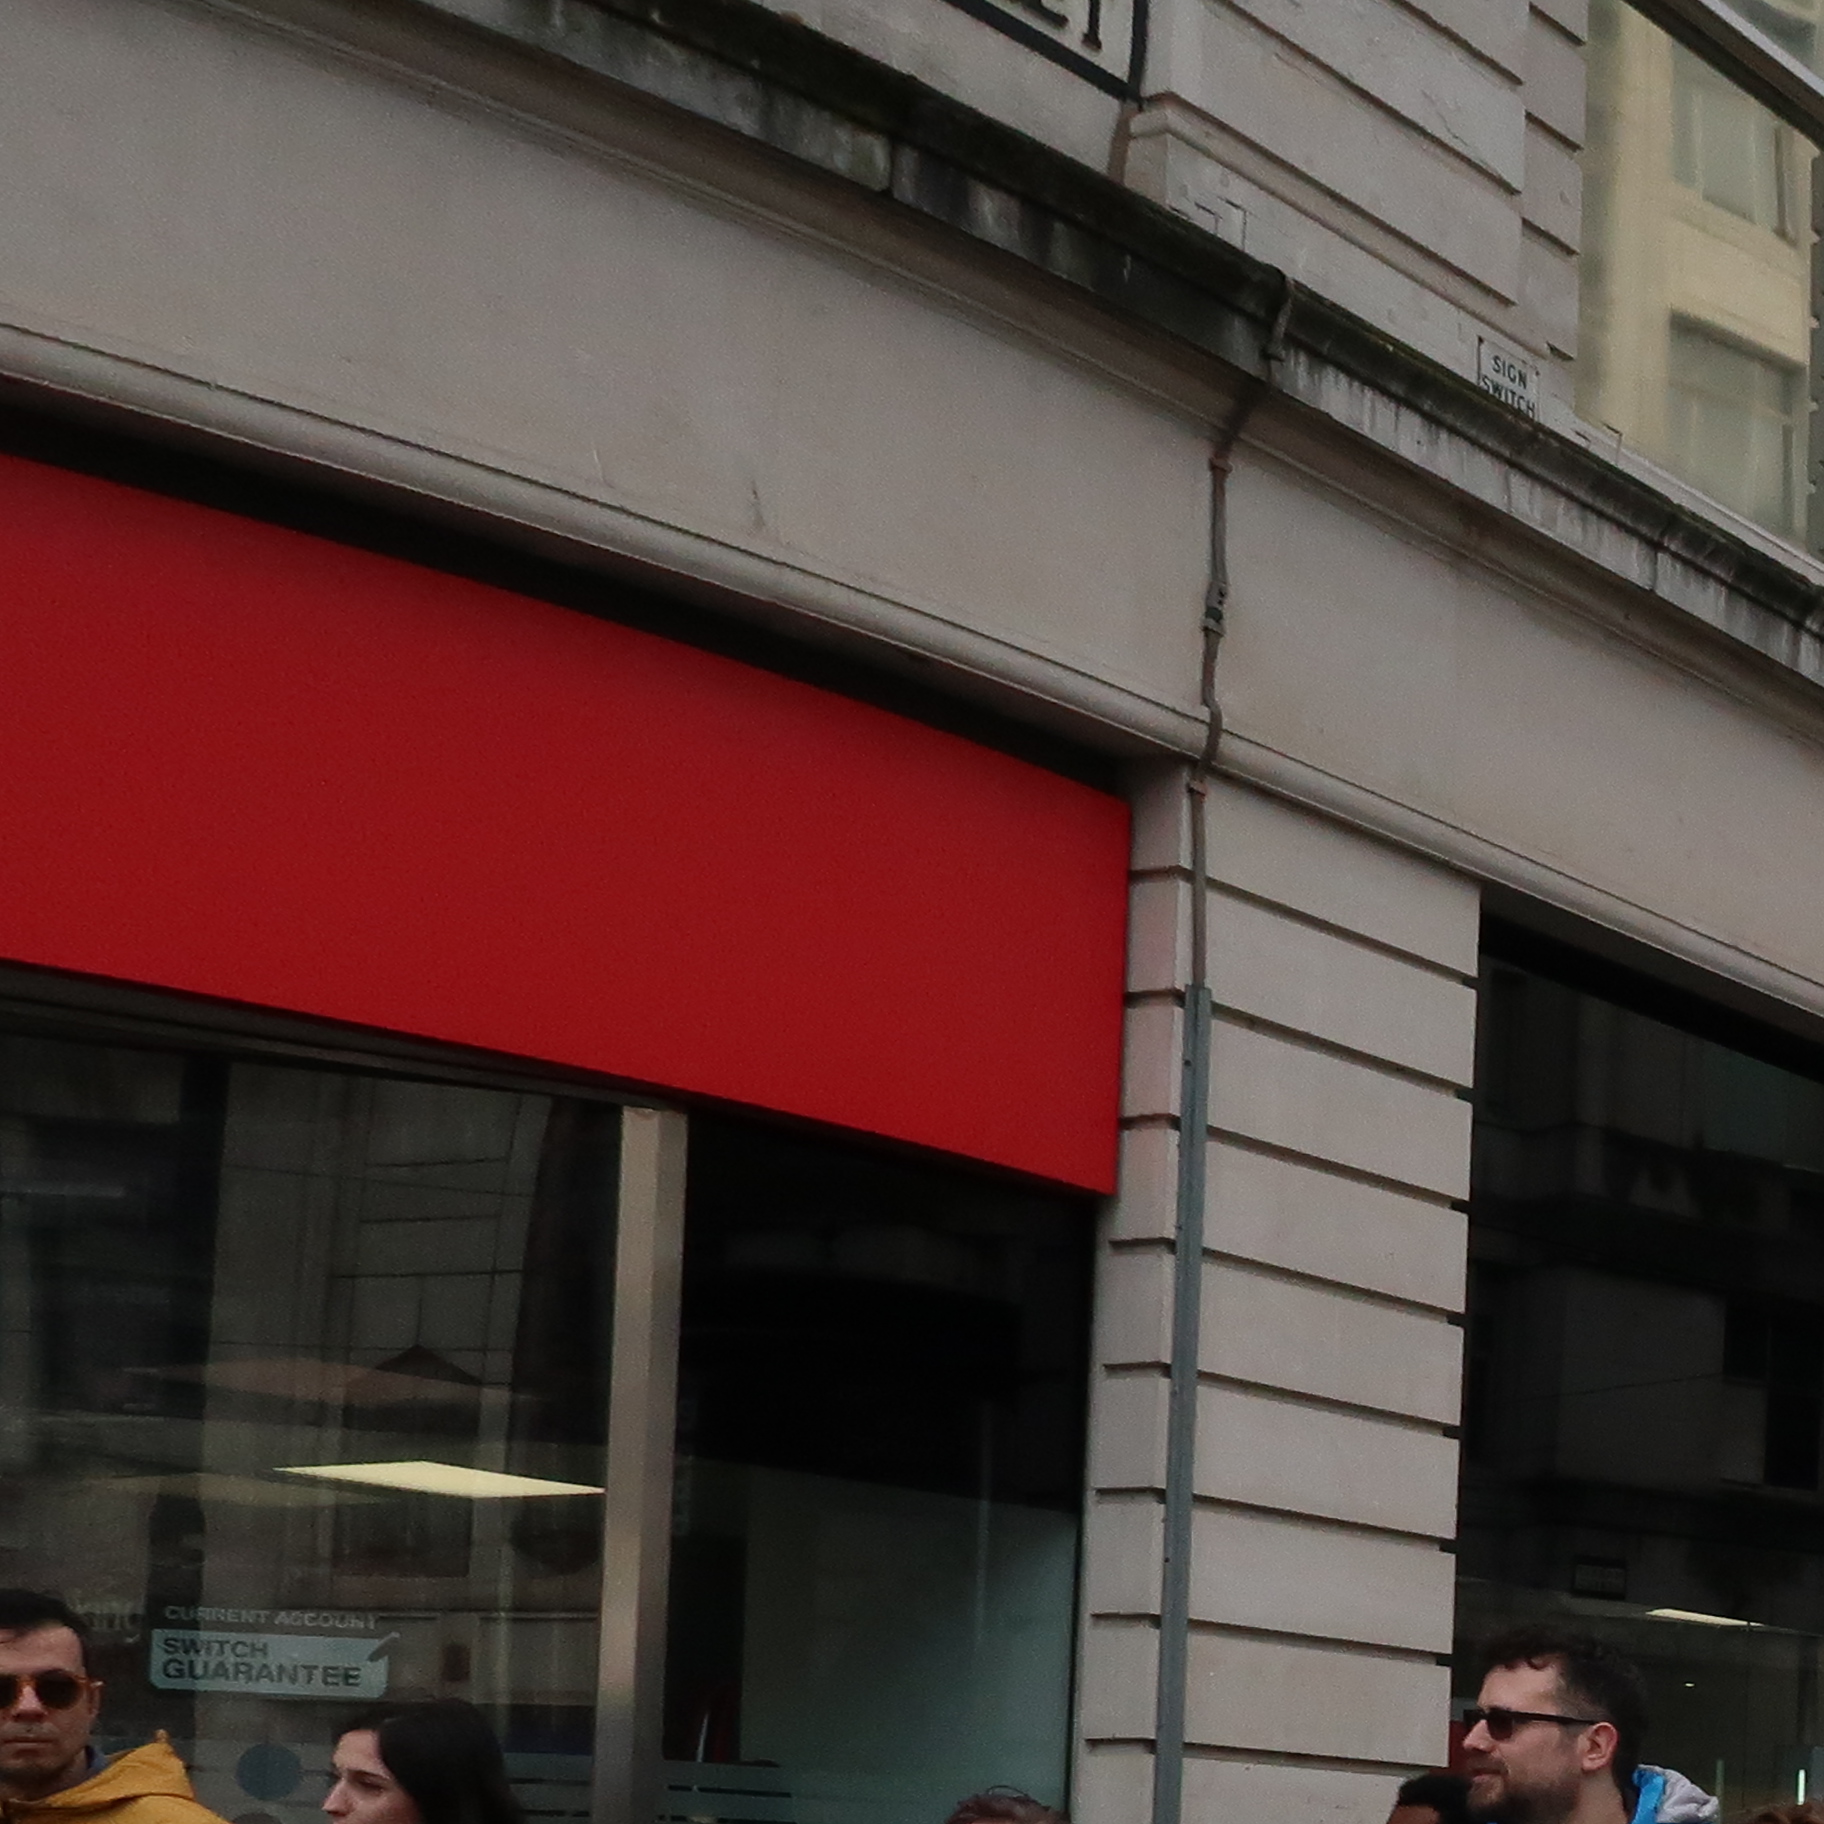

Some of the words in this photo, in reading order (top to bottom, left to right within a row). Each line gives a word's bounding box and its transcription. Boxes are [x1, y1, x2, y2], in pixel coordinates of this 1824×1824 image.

[1492, 354, 1527, 390] SIGN
[163, 1605, 272, 1627] CURRENT
[273, 1609, 379, 1631] ACCOUNT
[162, 1637, 269, 1659] SWITCH
[161, 1658, 363, 1689] GUARANTEE
